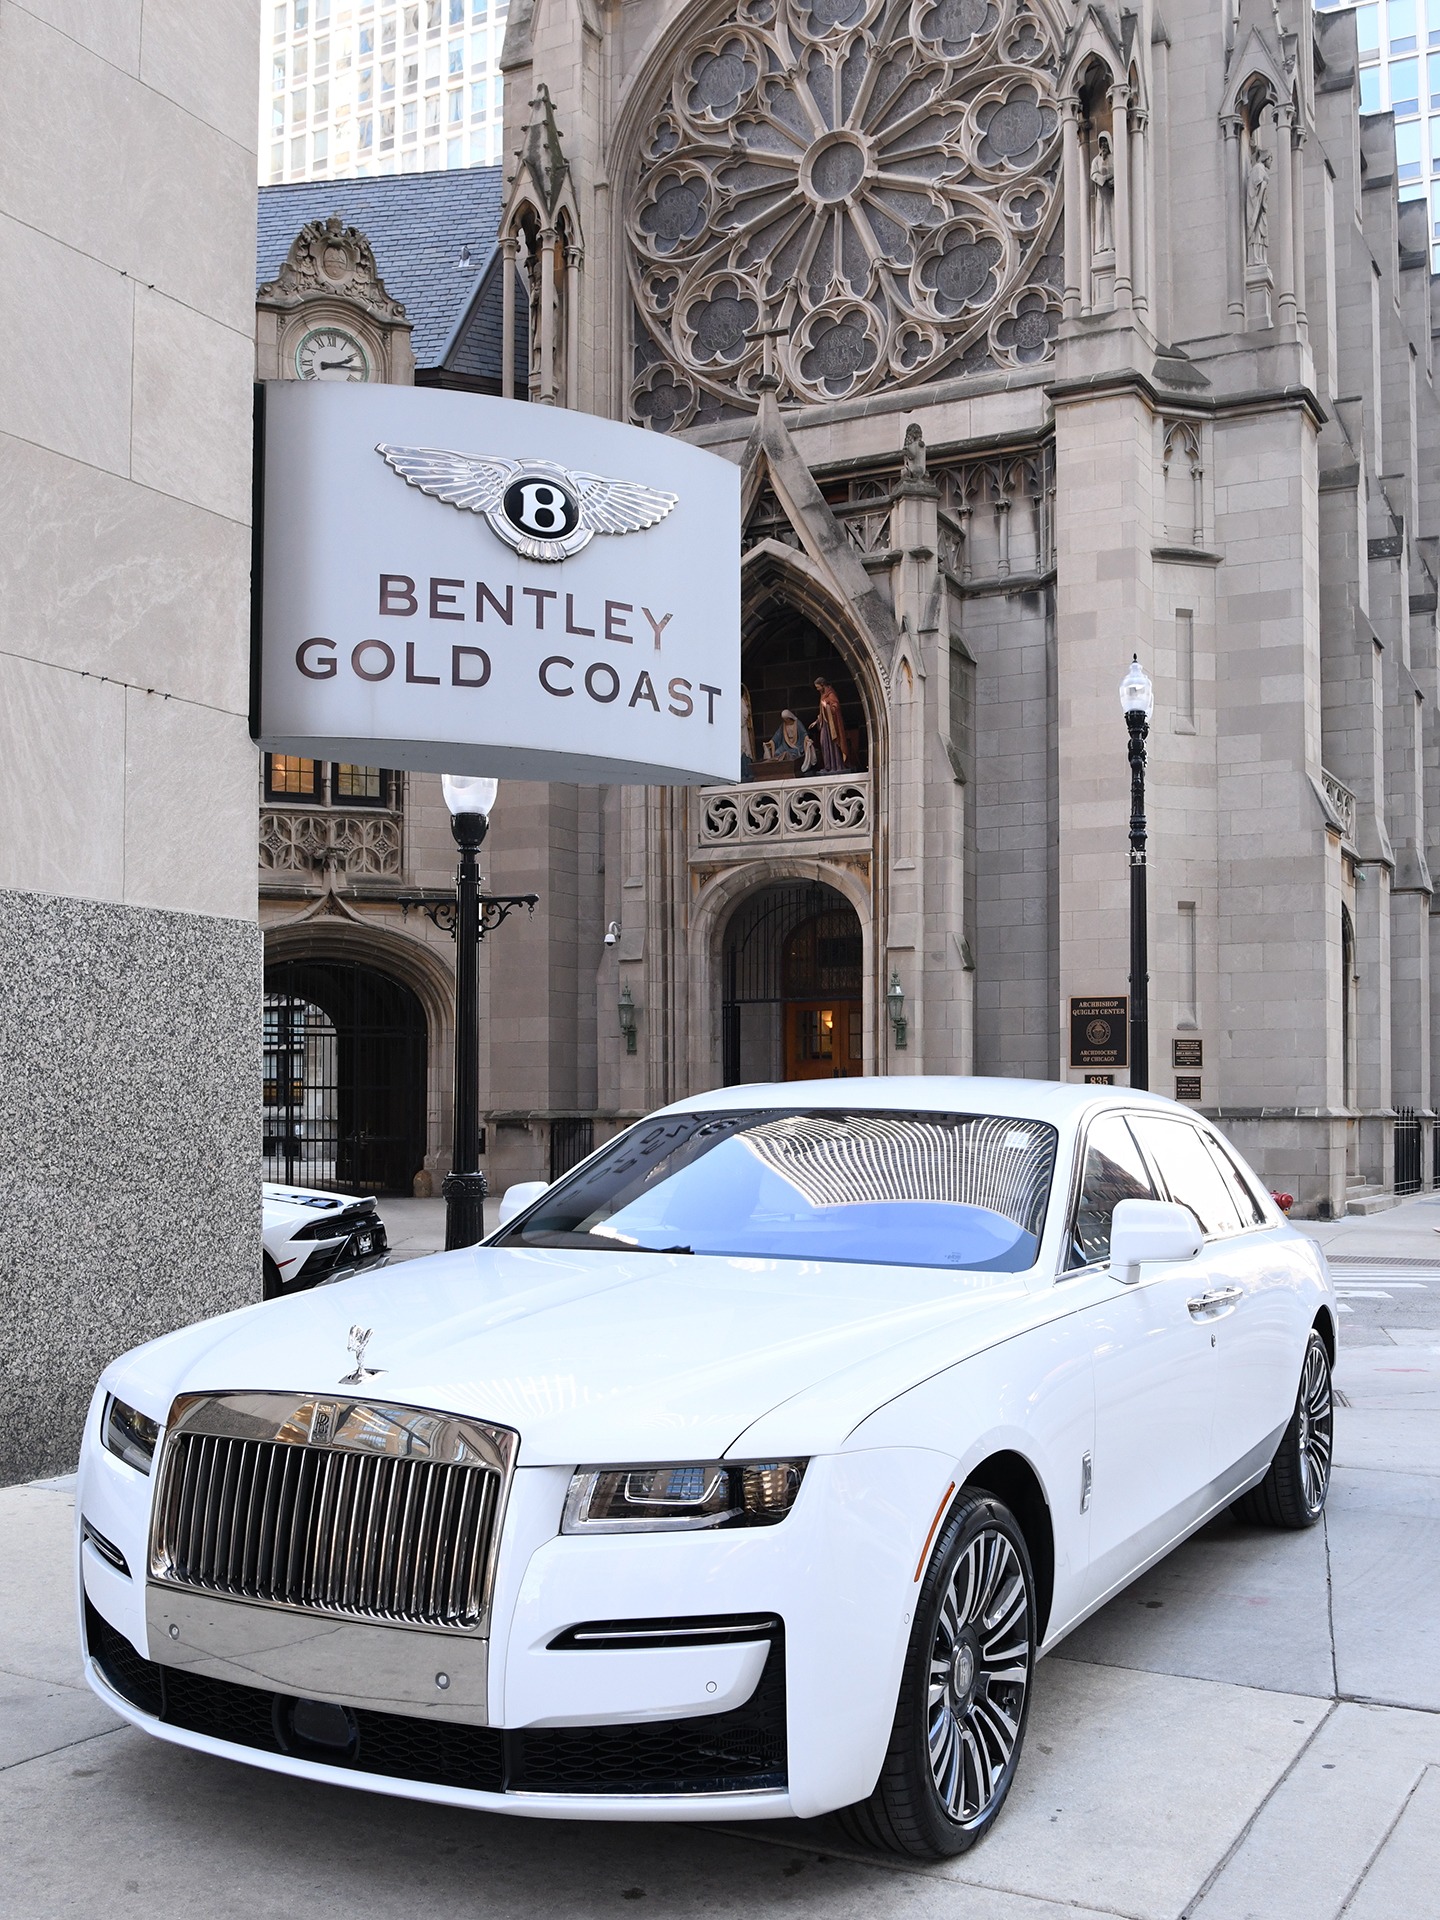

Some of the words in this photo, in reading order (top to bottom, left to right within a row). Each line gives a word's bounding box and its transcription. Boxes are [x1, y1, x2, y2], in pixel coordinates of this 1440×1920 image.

[378, 573, 674, 650] BENTLEY
[295, 637, 492, 688] GOLD
[538, 655, 723, 725] COAST
